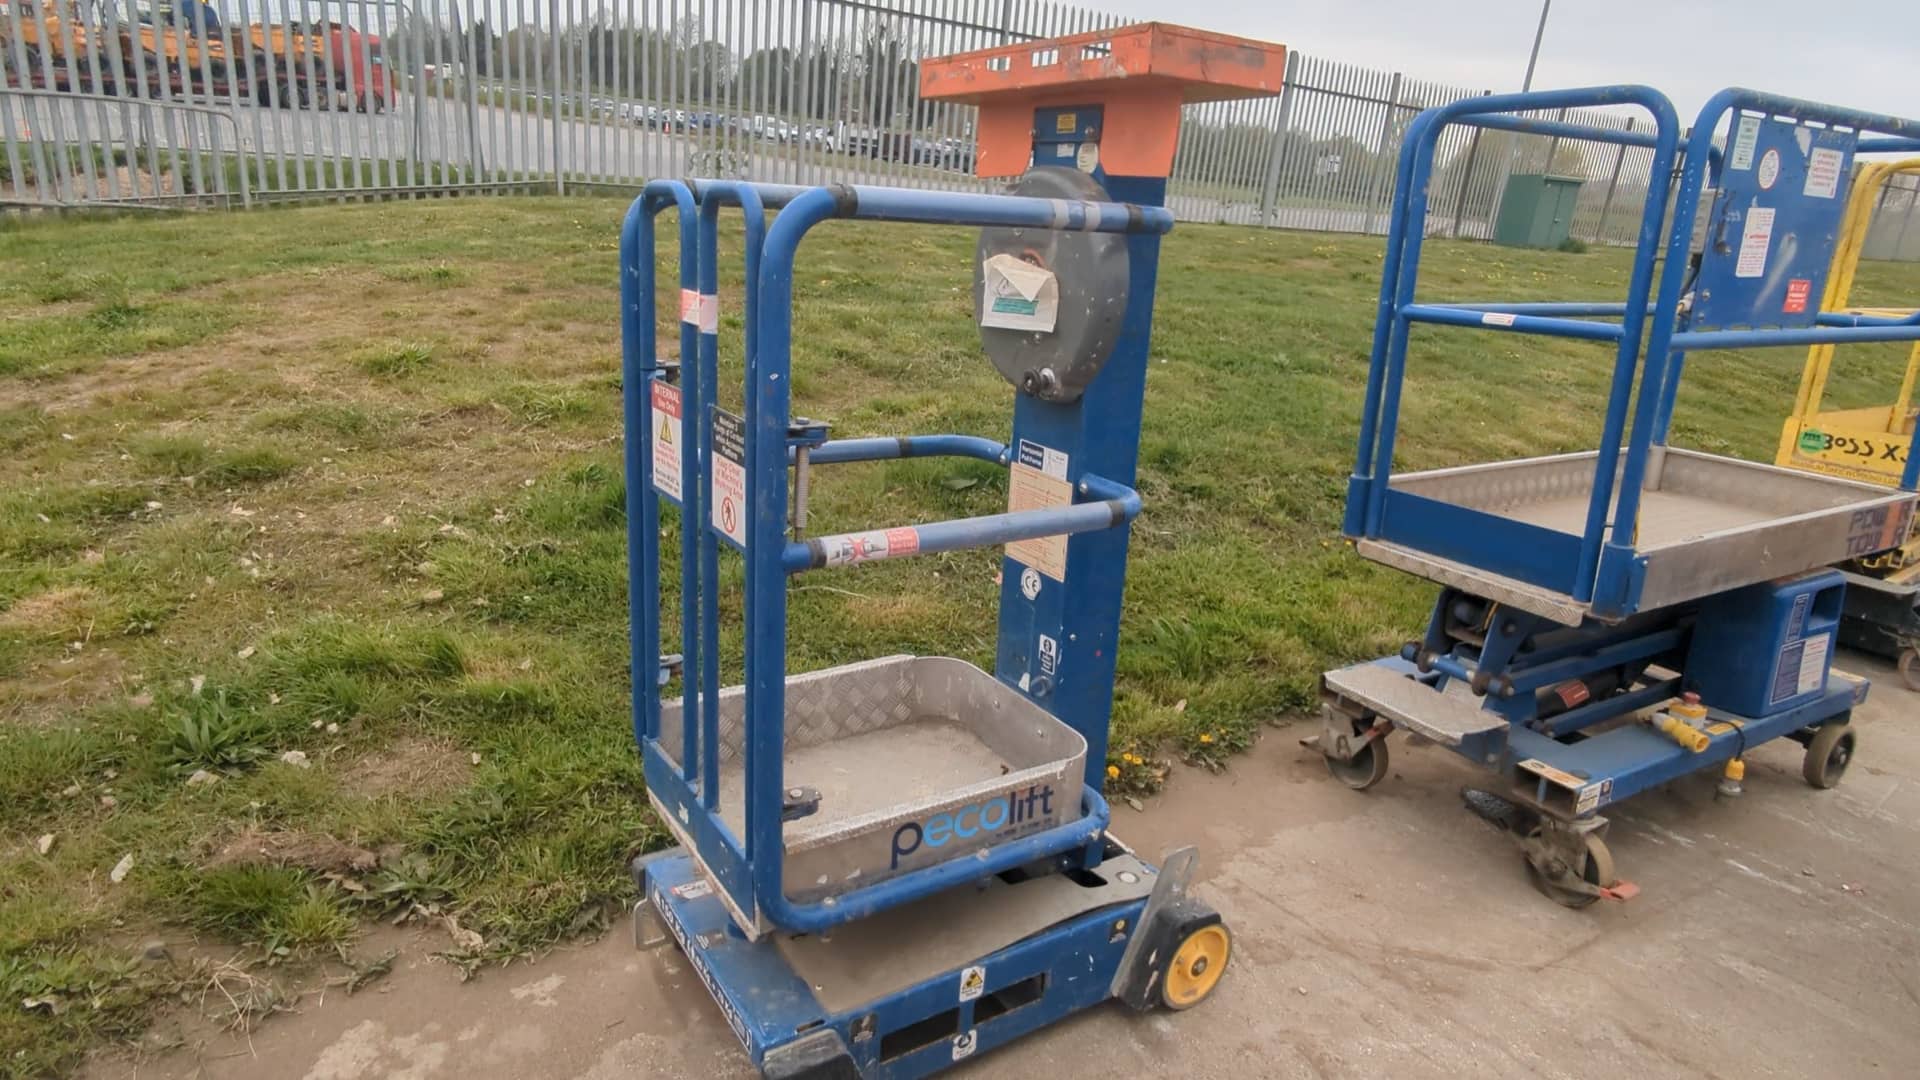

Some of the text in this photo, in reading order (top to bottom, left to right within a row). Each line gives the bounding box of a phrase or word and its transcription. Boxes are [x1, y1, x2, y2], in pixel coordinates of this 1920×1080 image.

[654, 383, 680, 403] INTERNAL
[1823, 432, 1875, 457] BOSS
[1880, 443, 1907, 463] X
[890, 784, 1054, 870] pecolift
